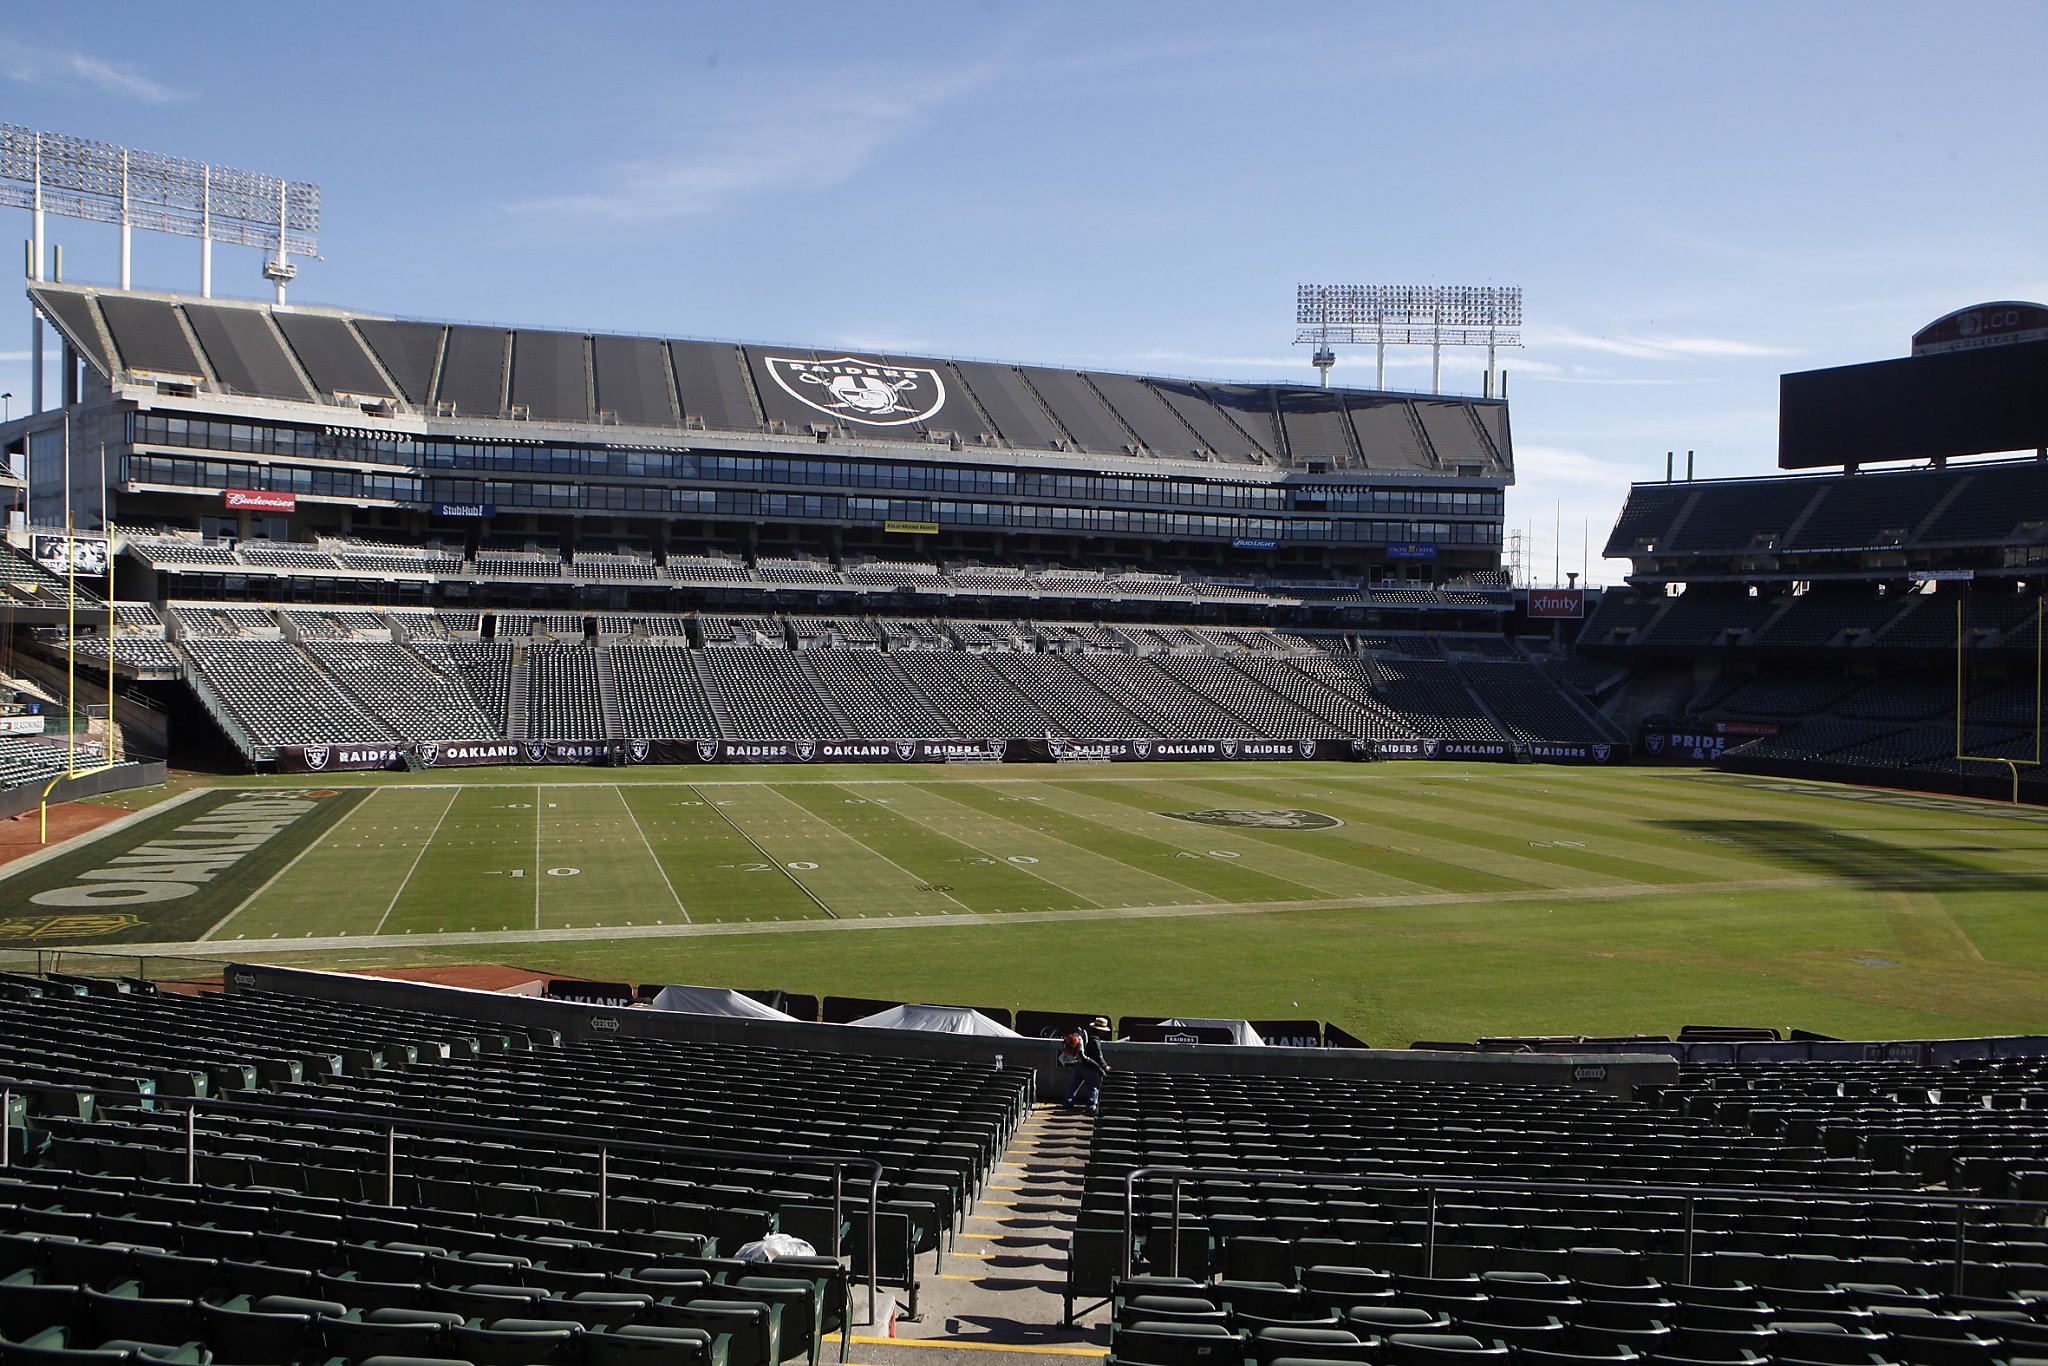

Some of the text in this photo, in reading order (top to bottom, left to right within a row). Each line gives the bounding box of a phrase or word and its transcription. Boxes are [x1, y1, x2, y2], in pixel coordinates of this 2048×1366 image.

[789, 362, 918, 379] RAIDERS
[227, 492, 295, 508] Budweiser
[442, 504, 483, 517] StubHub!
[1534, 596, 1578, 612] xfinity
[1671, 734, 1725, 749] PRIDE
[447, 745, 519, 759] OAKLAND
[726, 745, 788, 756] RAIDERS
[823, 745, 890, 756] OAKLAND
[1157, 744, 1216, 755] OAKLAND
[1244, 744, 1294, 754] RAIDERS
[1445, 744, 1504, 755] OAKLAND
[1534, 747, 1586, 758] RAIDERS
[29, 799, 319, 907] OAKLAND
[1169, 1036, 1195, 1044] RAIDERS
